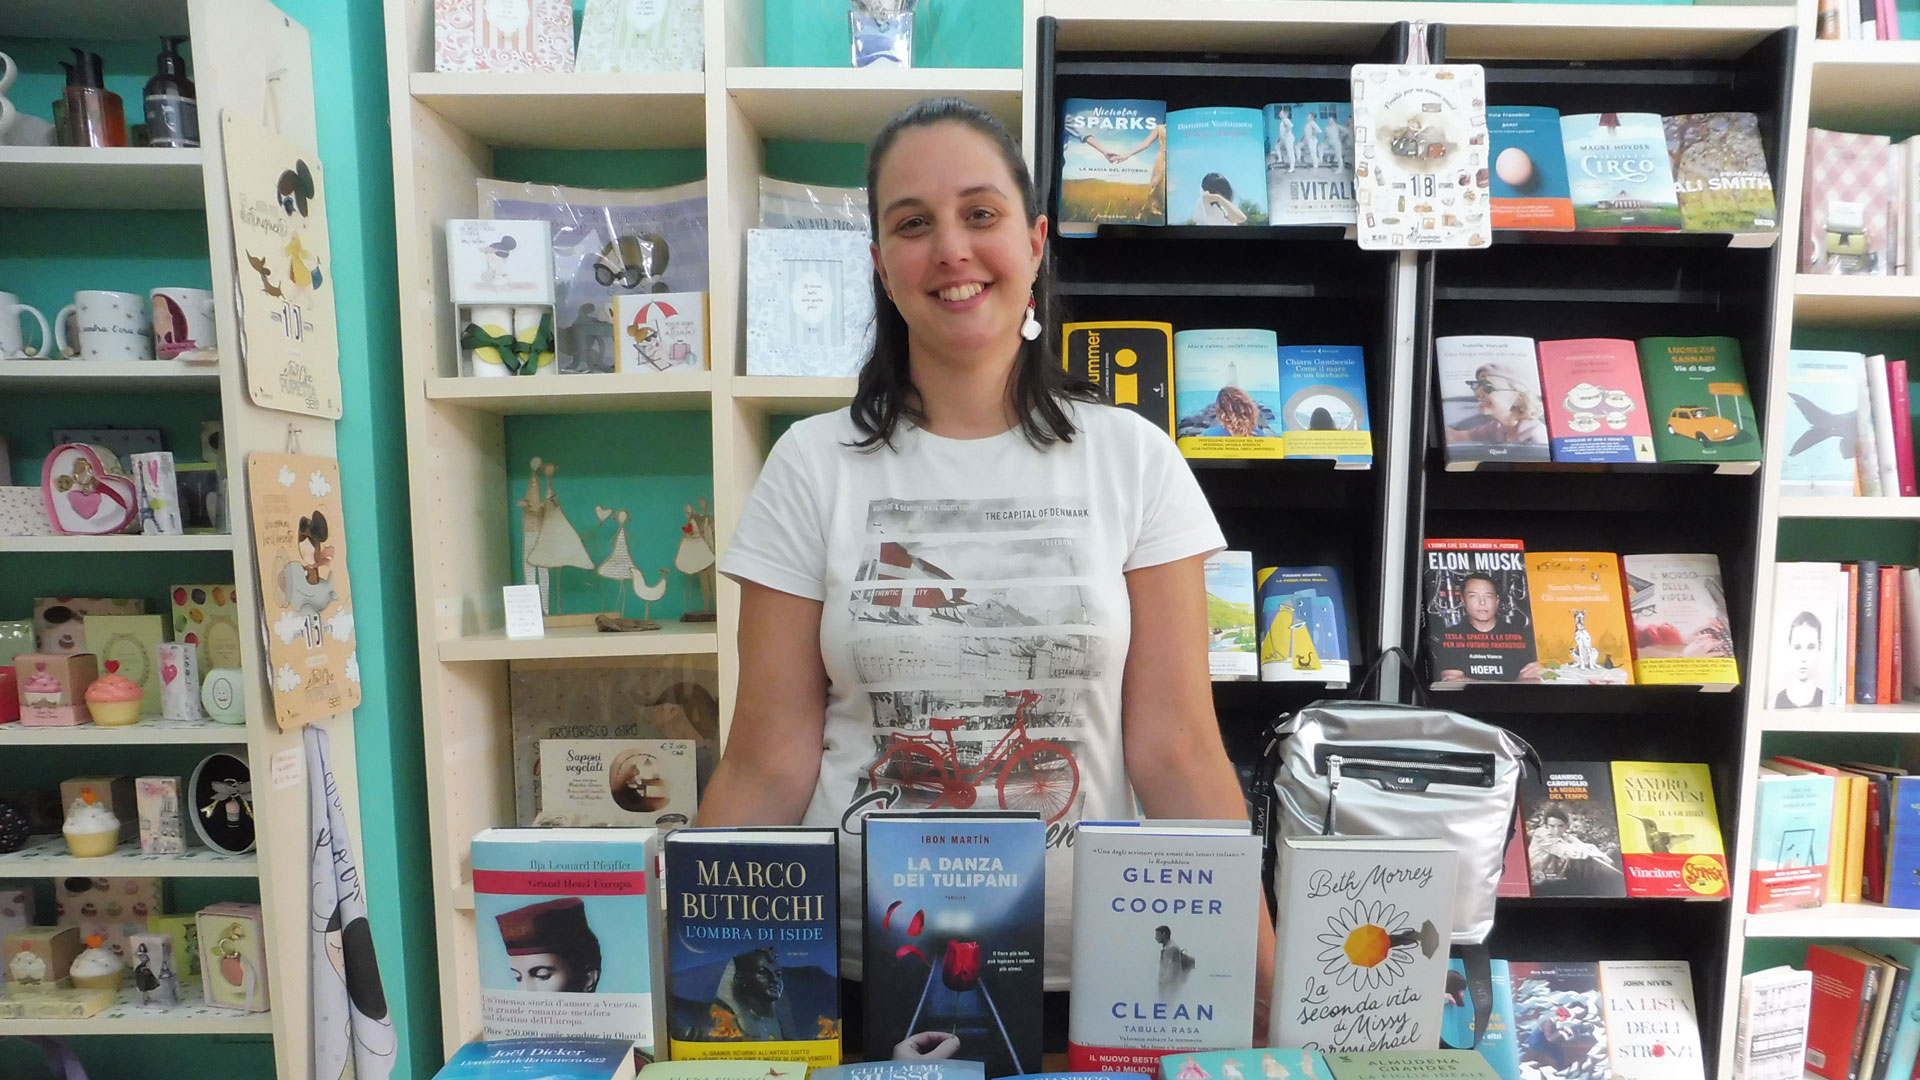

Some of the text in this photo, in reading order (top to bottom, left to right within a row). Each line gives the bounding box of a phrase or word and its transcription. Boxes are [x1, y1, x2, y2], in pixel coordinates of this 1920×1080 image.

[1093, 107, 1138, 116] Nicholas
[1074, 116, 1157, 130] SPARKS
[1581, 154, 1655, 183] CIRCO
[1411, 176, 1433, 197] 18
[1673, 177, 1773, 193] ALI SMITH
[1088, 330, 1100, 384] ummer
[986, 508, 1089, 520] THE CAPITAL OF DENMARK
[1428, 552, 1523, 570] ELON MUSK
[1662, 582, 1690, 590] DELLA
[1470, 665, 1504, 675] HOEPLI
[567, 749, 601, 765] Saponi
[566, 762, 603, 775] vegetali
[1625, 778, 1688, 790] SANDRO
[1626, 790, 1705, 802] VERONESI
[922, 834, 990, 844] IBON MARTÍN
[550, 861, 590, 870] Leonard
[908, 857, 1003, 871] LA DANZA
[696, 860, 806, 888] MARCO
[1123, 867, 1213, 884] GLENN
[1629, 866, 1681, 878] Vincitore
[529, 879, 561, 888] Grand
[893, 873, 1018, 888] DEI TULIPANI
[1308, 865, 1434, 900] Beth Morrey
[681, 893, 825, 921] BUTICCHI
[1111, 897, 1223, 915] COOPER
[685, 925, 823, 941] L'OMBRA DI ISIDE
[1300, 976, 1329, 1004] La
[496, 1005, 524, 1016] grande
[571, 1008, 611, 1017] metafora
[1297, 985, 1421, 1025] seconda vita
[1611, 998, 1635, 1011] LA
[1111, 1002, 1214, 1021] CLEAN
[497, 1015, 528, 1023] destino
[603, 1031, 612, 1039] in
[615, 1031, 647, 1039] Olanda
[1124, 1025, 1200, 1034] TABULA RASA
[1333, 1012, 1411, 1046] di Missy
[530, 1048, 586, 1057] Dicker
[1100, 1055, 1129, 1063] NUOVO
[1132, 1056, 1160, 1064] BESTS
[1368, 1058, 1460, 1067] ALMUDENA
[851, 1064, 945, 1074] GUILLAUME
[851, 1072, 943, 1080] MUSSO
